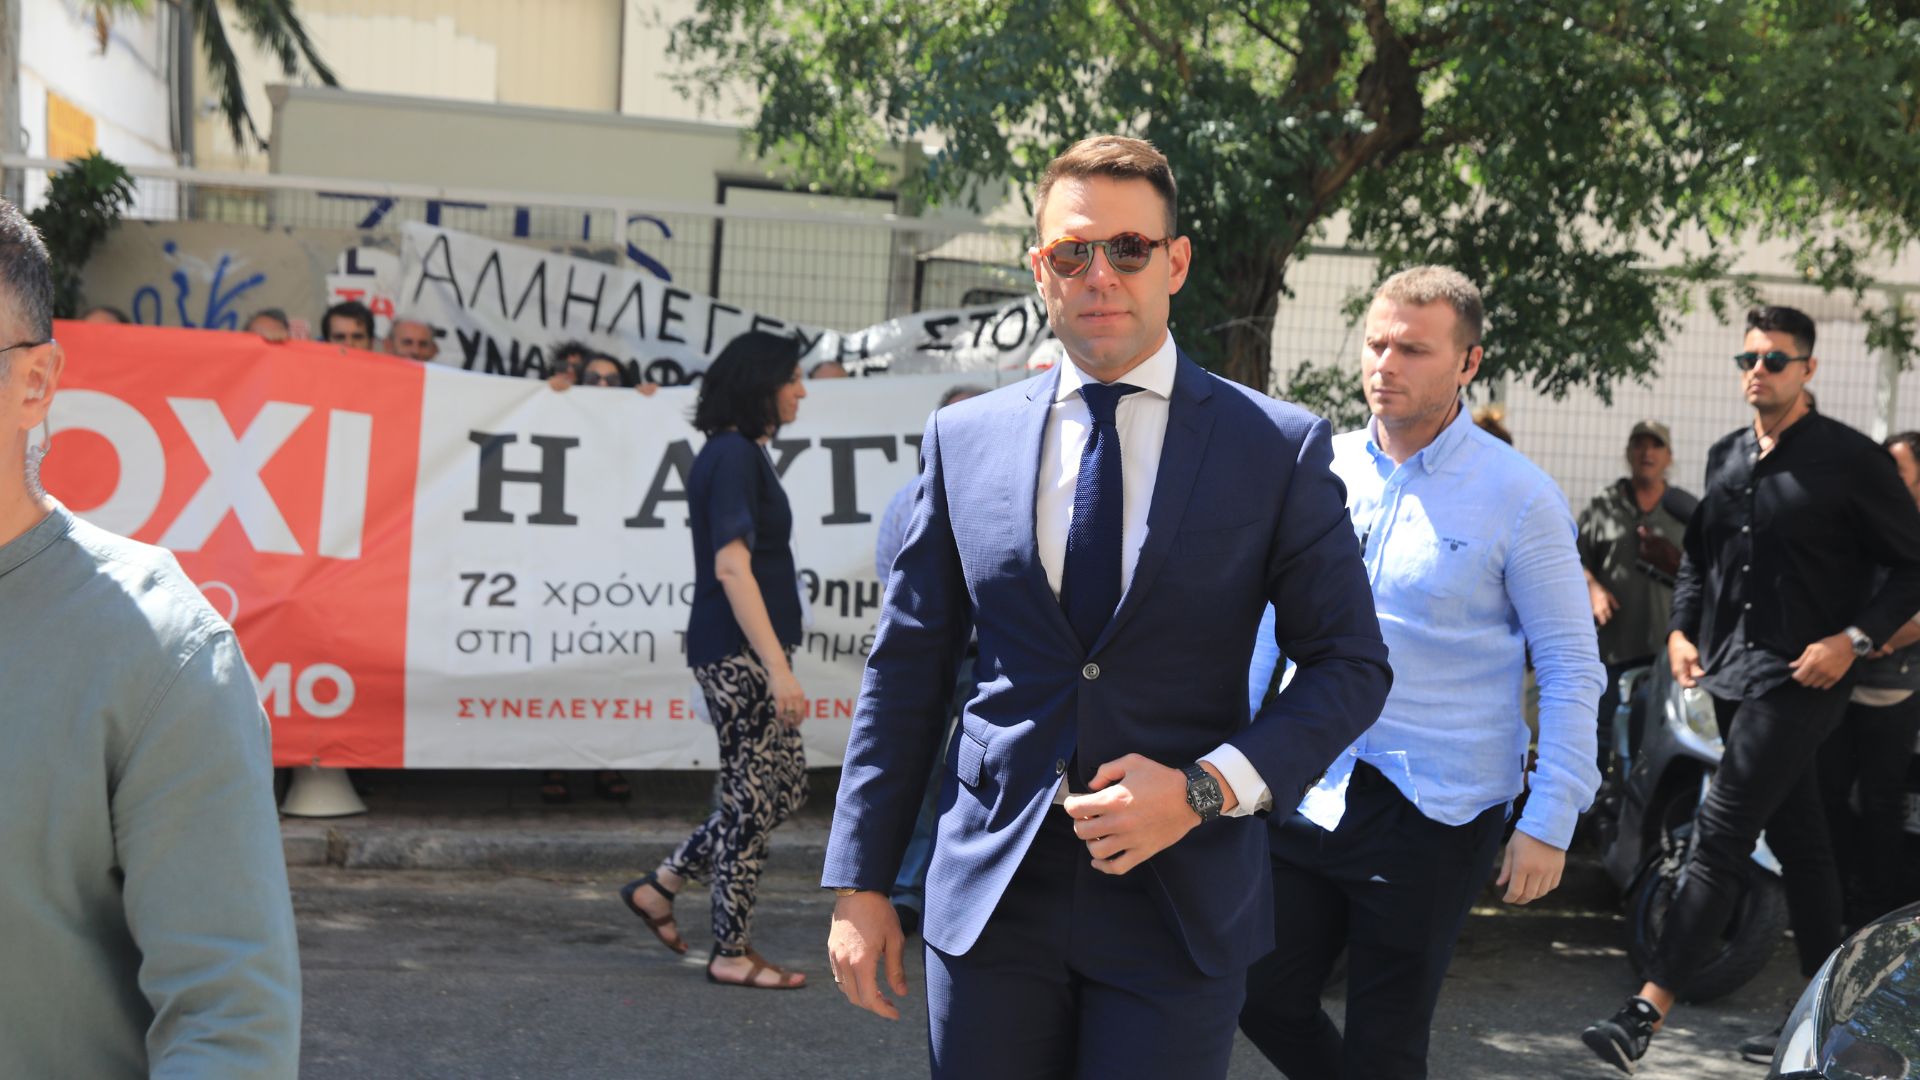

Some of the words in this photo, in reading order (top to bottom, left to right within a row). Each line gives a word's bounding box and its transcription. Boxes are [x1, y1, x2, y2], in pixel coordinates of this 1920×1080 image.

[916, 301, 1053, 352] ΣΤΟΥ
[459, 573, 517, 607] 72
[456, 628, 532, 663] στη
[551, 620, 656, 663] μάχη
[458, 698, 653, 720] ΣΥΝΕΛΕΥΣΗ
